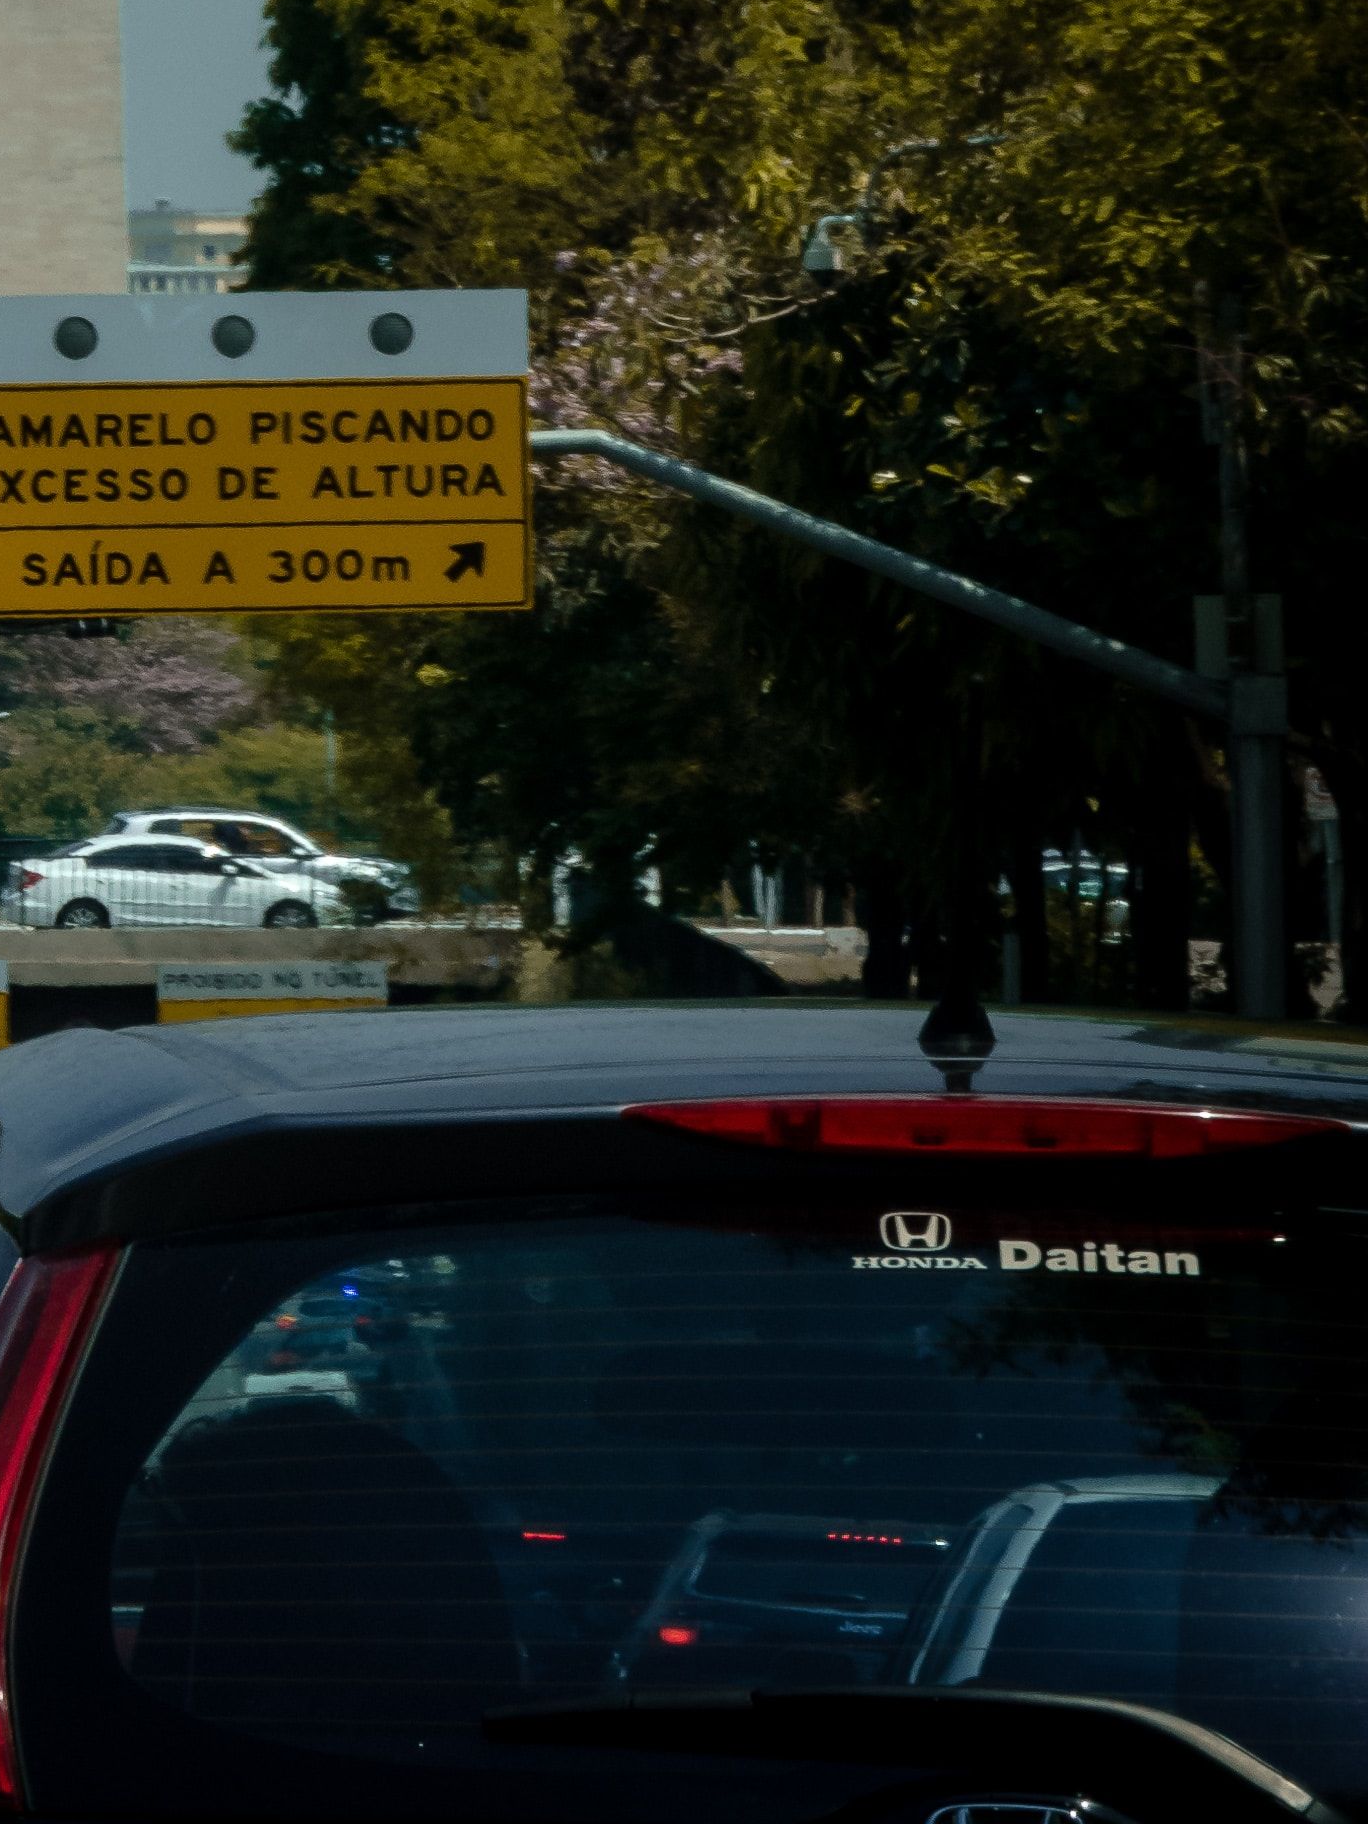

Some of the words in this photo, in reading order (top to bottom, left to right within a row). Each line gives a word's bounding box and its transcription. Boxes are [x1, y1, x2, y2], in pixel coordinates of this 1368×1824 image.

[248, 407, 496, 445] PISCANDO
[217, 466, 280, 501] DE
[311, 462, 505, 499] ALTURA
[21, 539, 170, 587] SAÍDA
[202, 551, 237, 585] A
[268, 548, 412, 583] 300m
[851, 1256, 988, 1270] HONDA
[998, 1239, 1201, 1276] Daitan
